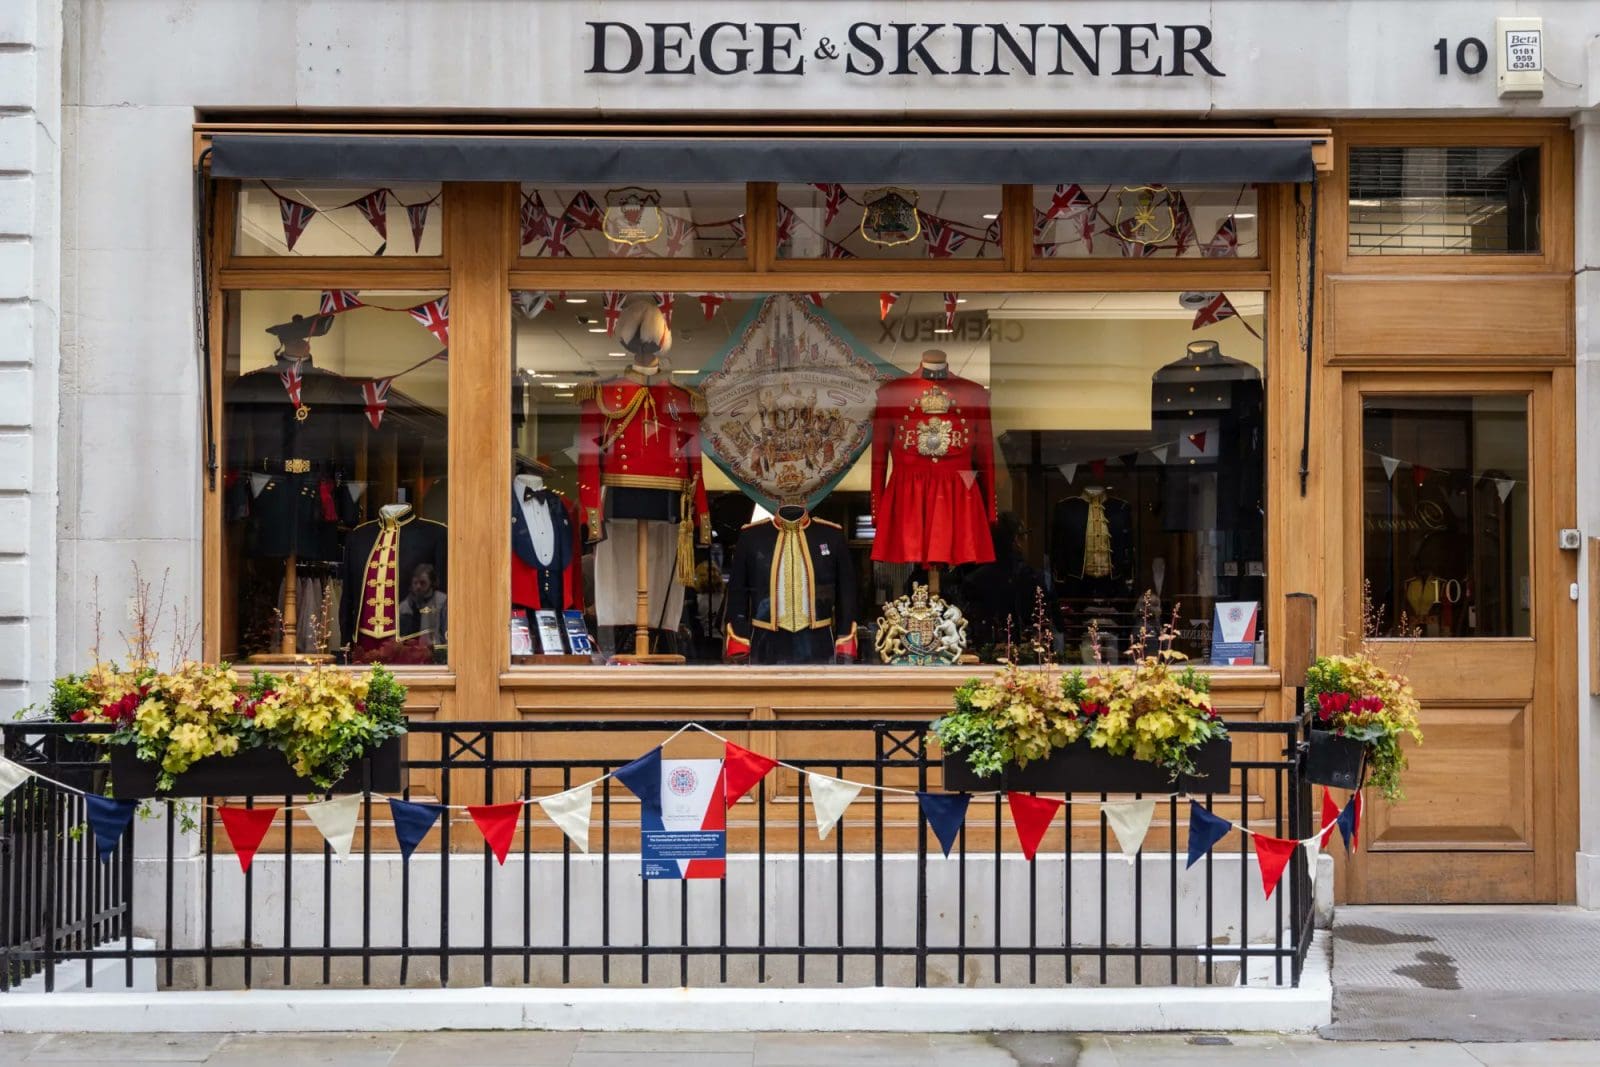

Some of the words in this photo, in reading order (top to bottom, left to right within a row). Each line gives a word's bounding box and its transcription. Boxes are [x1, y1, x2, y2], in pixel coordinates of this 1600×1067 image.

[584, 21, 805, 76] DEGE
[814, 36, 839, 61] &
[845, 21, 1226, 77] SKINNER
[1511, 35, 1538, 44] Beta
[1434, 37, 1488, 74] 10
[1431, 578, 1461, 603] 10
